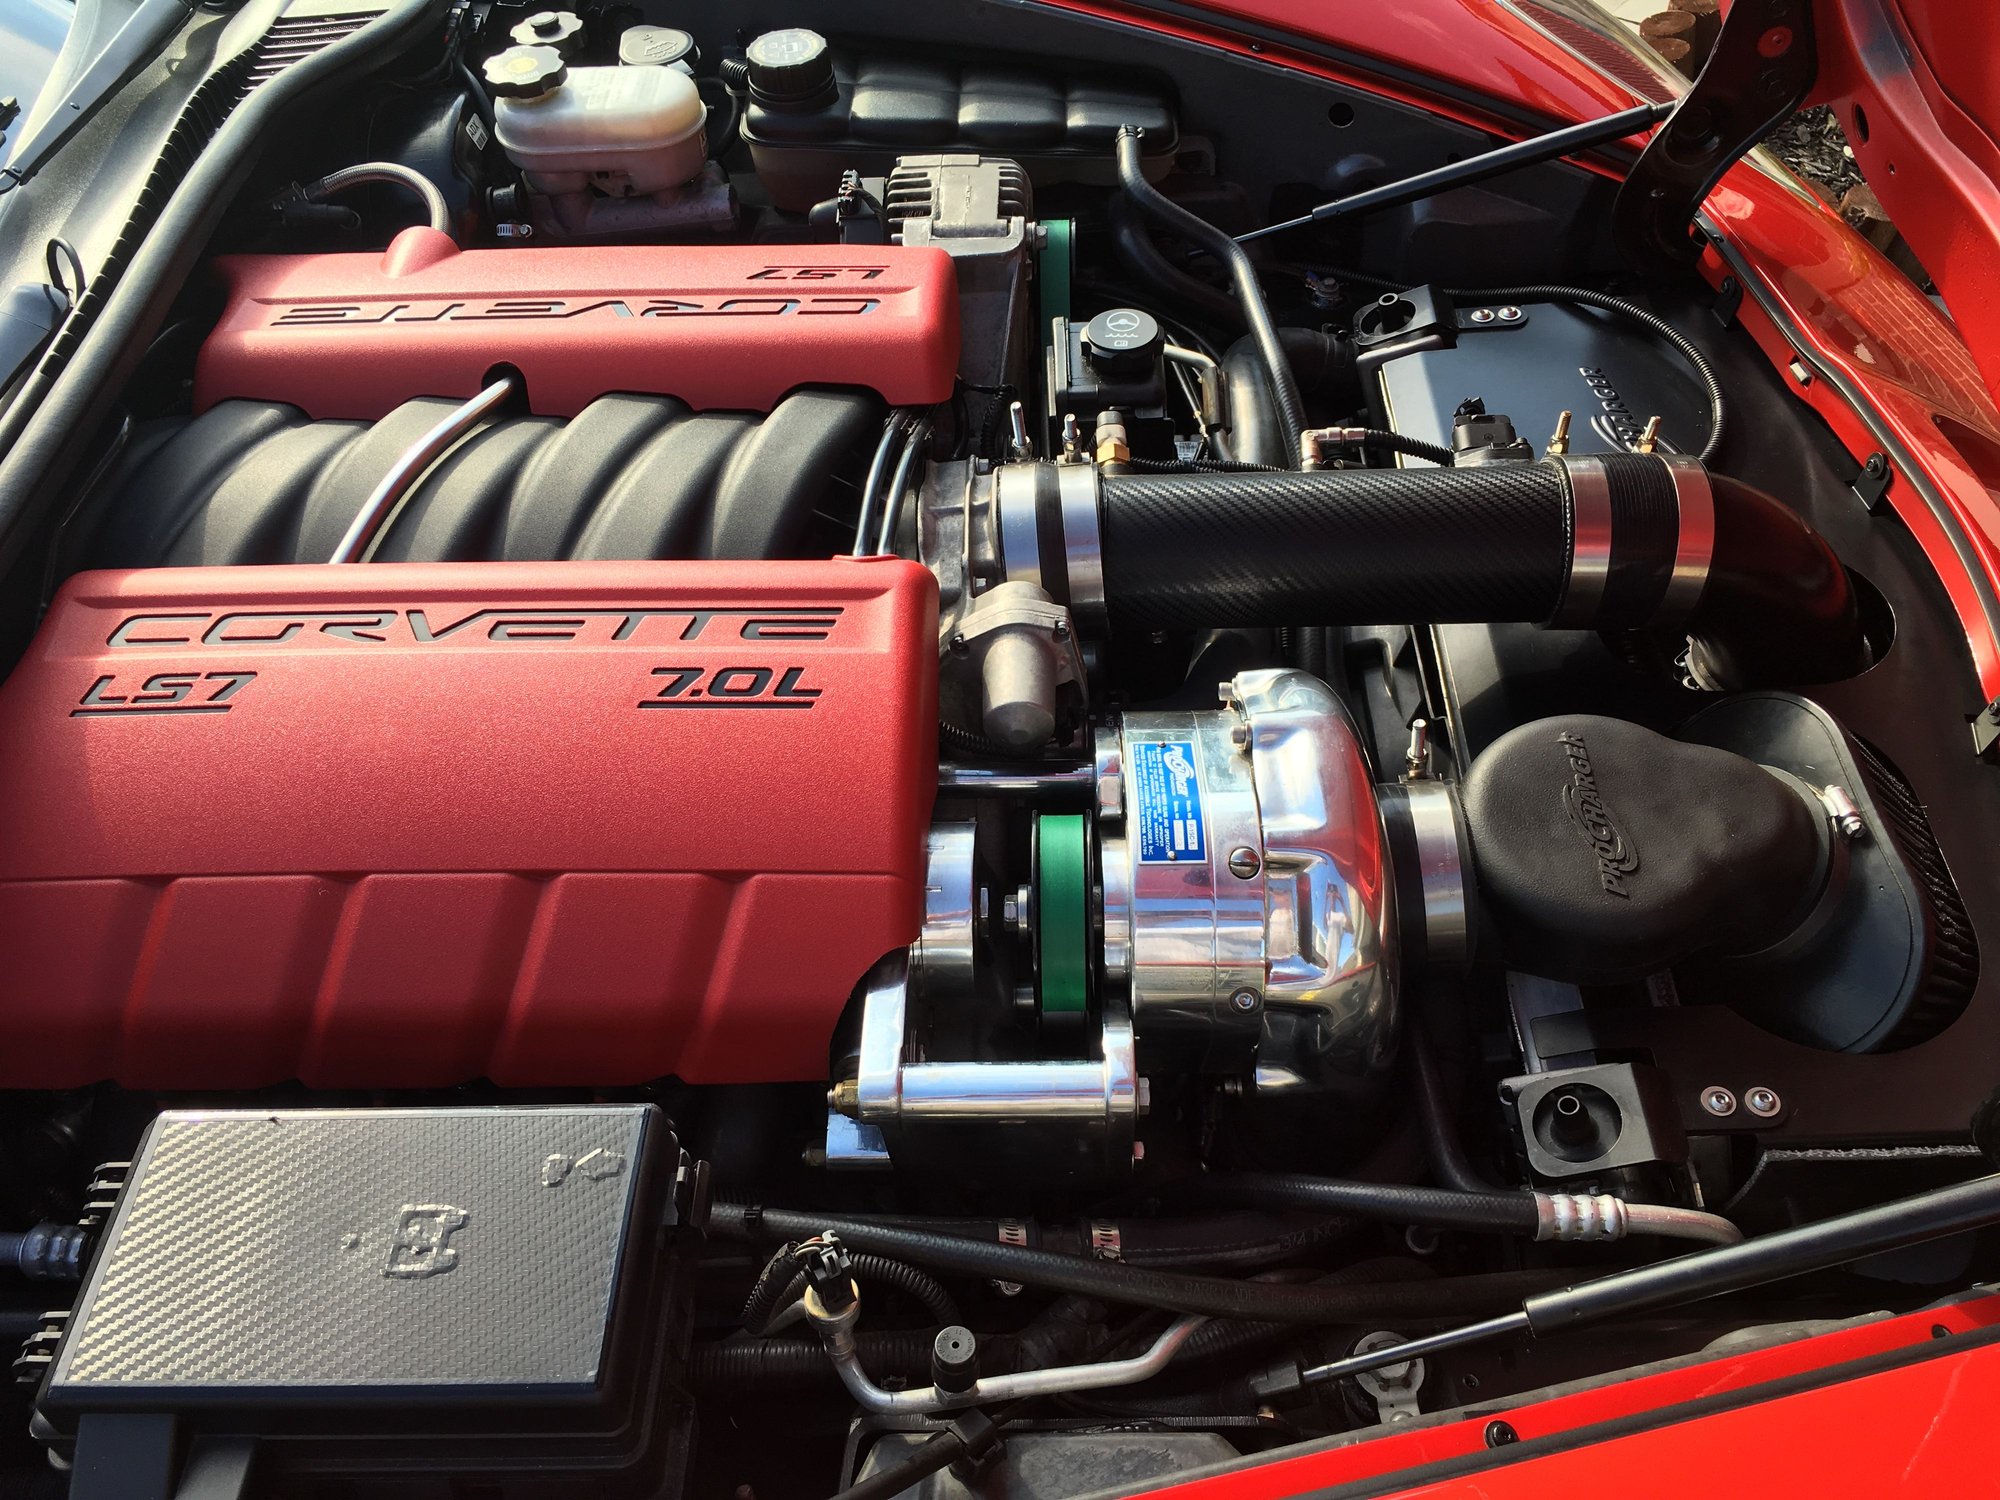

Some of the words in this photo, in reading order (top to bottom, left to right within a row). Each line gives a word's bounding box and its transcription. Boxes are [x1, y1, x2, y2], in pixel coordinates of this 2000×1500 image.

[746, 267, 888, 281] LS7
[272, 297, 882, 327] CORVETTE
[106, 606, 845, 649] CORVETTE
[82, 670, 258, 707] LS7
[649, 666, 824, 699] 7.0L
[1555, 730, 1636, 899] PROCHARGER
